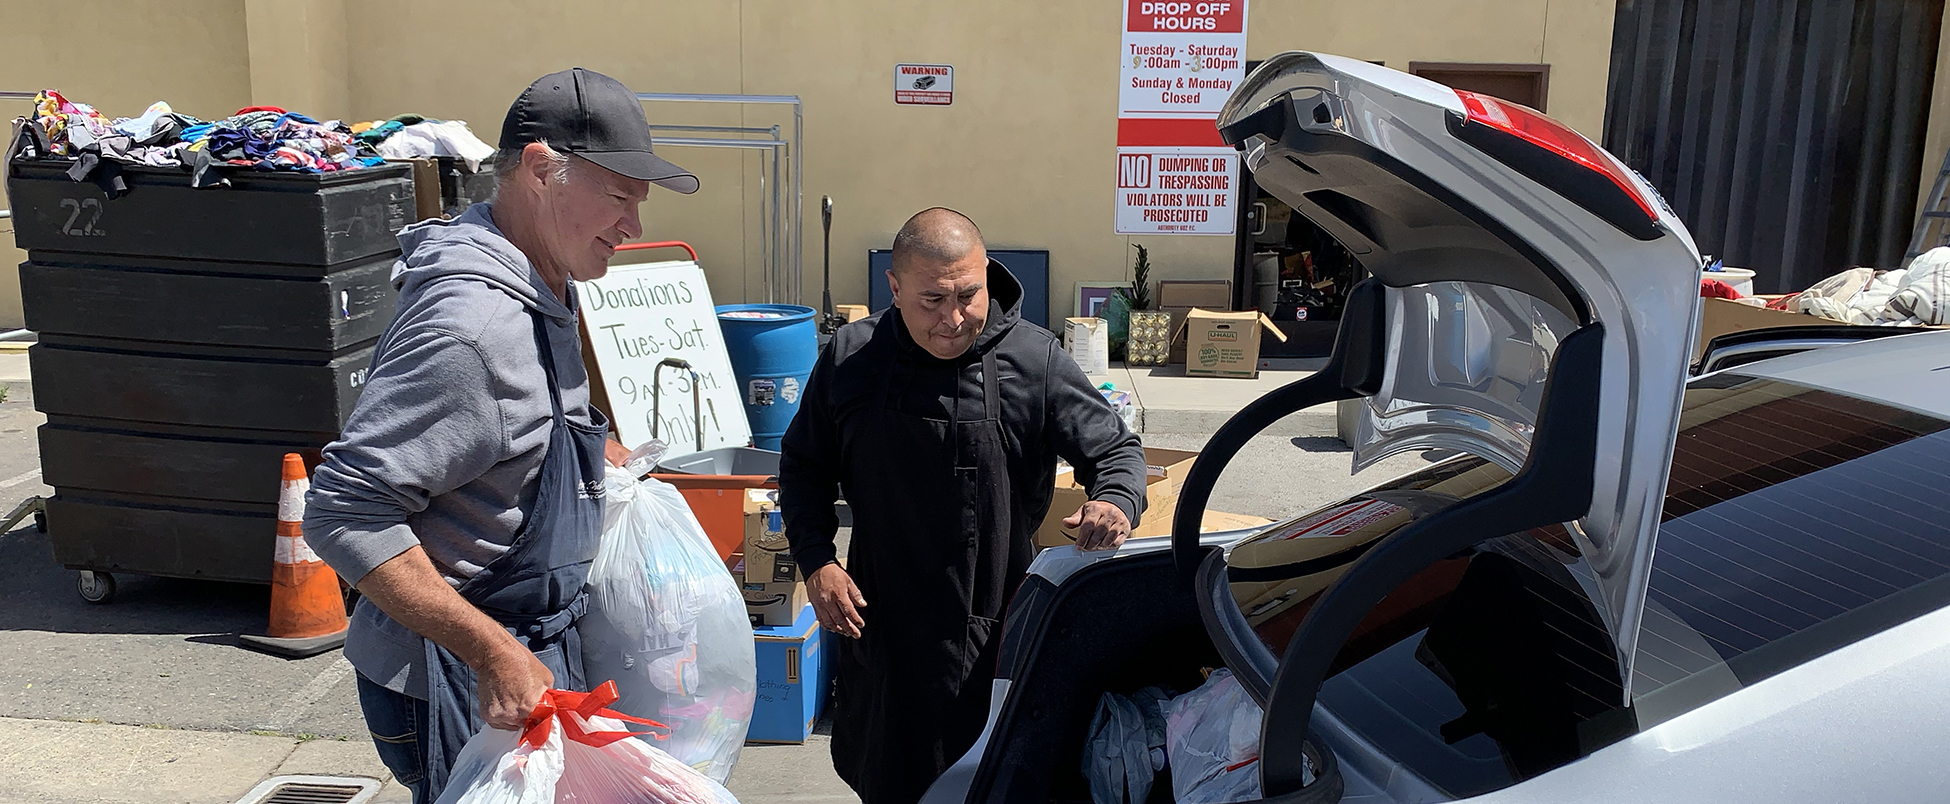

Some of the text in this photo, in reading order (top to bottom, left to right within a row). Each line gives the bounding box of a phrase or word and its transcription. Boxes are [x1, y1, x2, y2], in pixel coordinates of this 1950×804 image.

[1141, 2, 1231, 16] DROP OFF
[1153, 17, 1217, 30] HOURS
[1130, 44, 1175, 57] Tuesday
[1188, 44, 1238, 58] Saturday
[901, 67, 948, 75] WARNING
[1131, 77, 1232, 91] Sunday & Monday
[1161, 92, 1201, 104] Closed
[1120, 155, 1149, 188] NO
[1159, 158, 1226, 172] DUMPING OR
[1159, 175, 1229, 190] TRESPASSING
[1127, 193, 1227, 207] VIOLATORS WILL BE
[60, 198, 105, 236] 22
[1143, 209, 1208, 222] PROSECUTED
